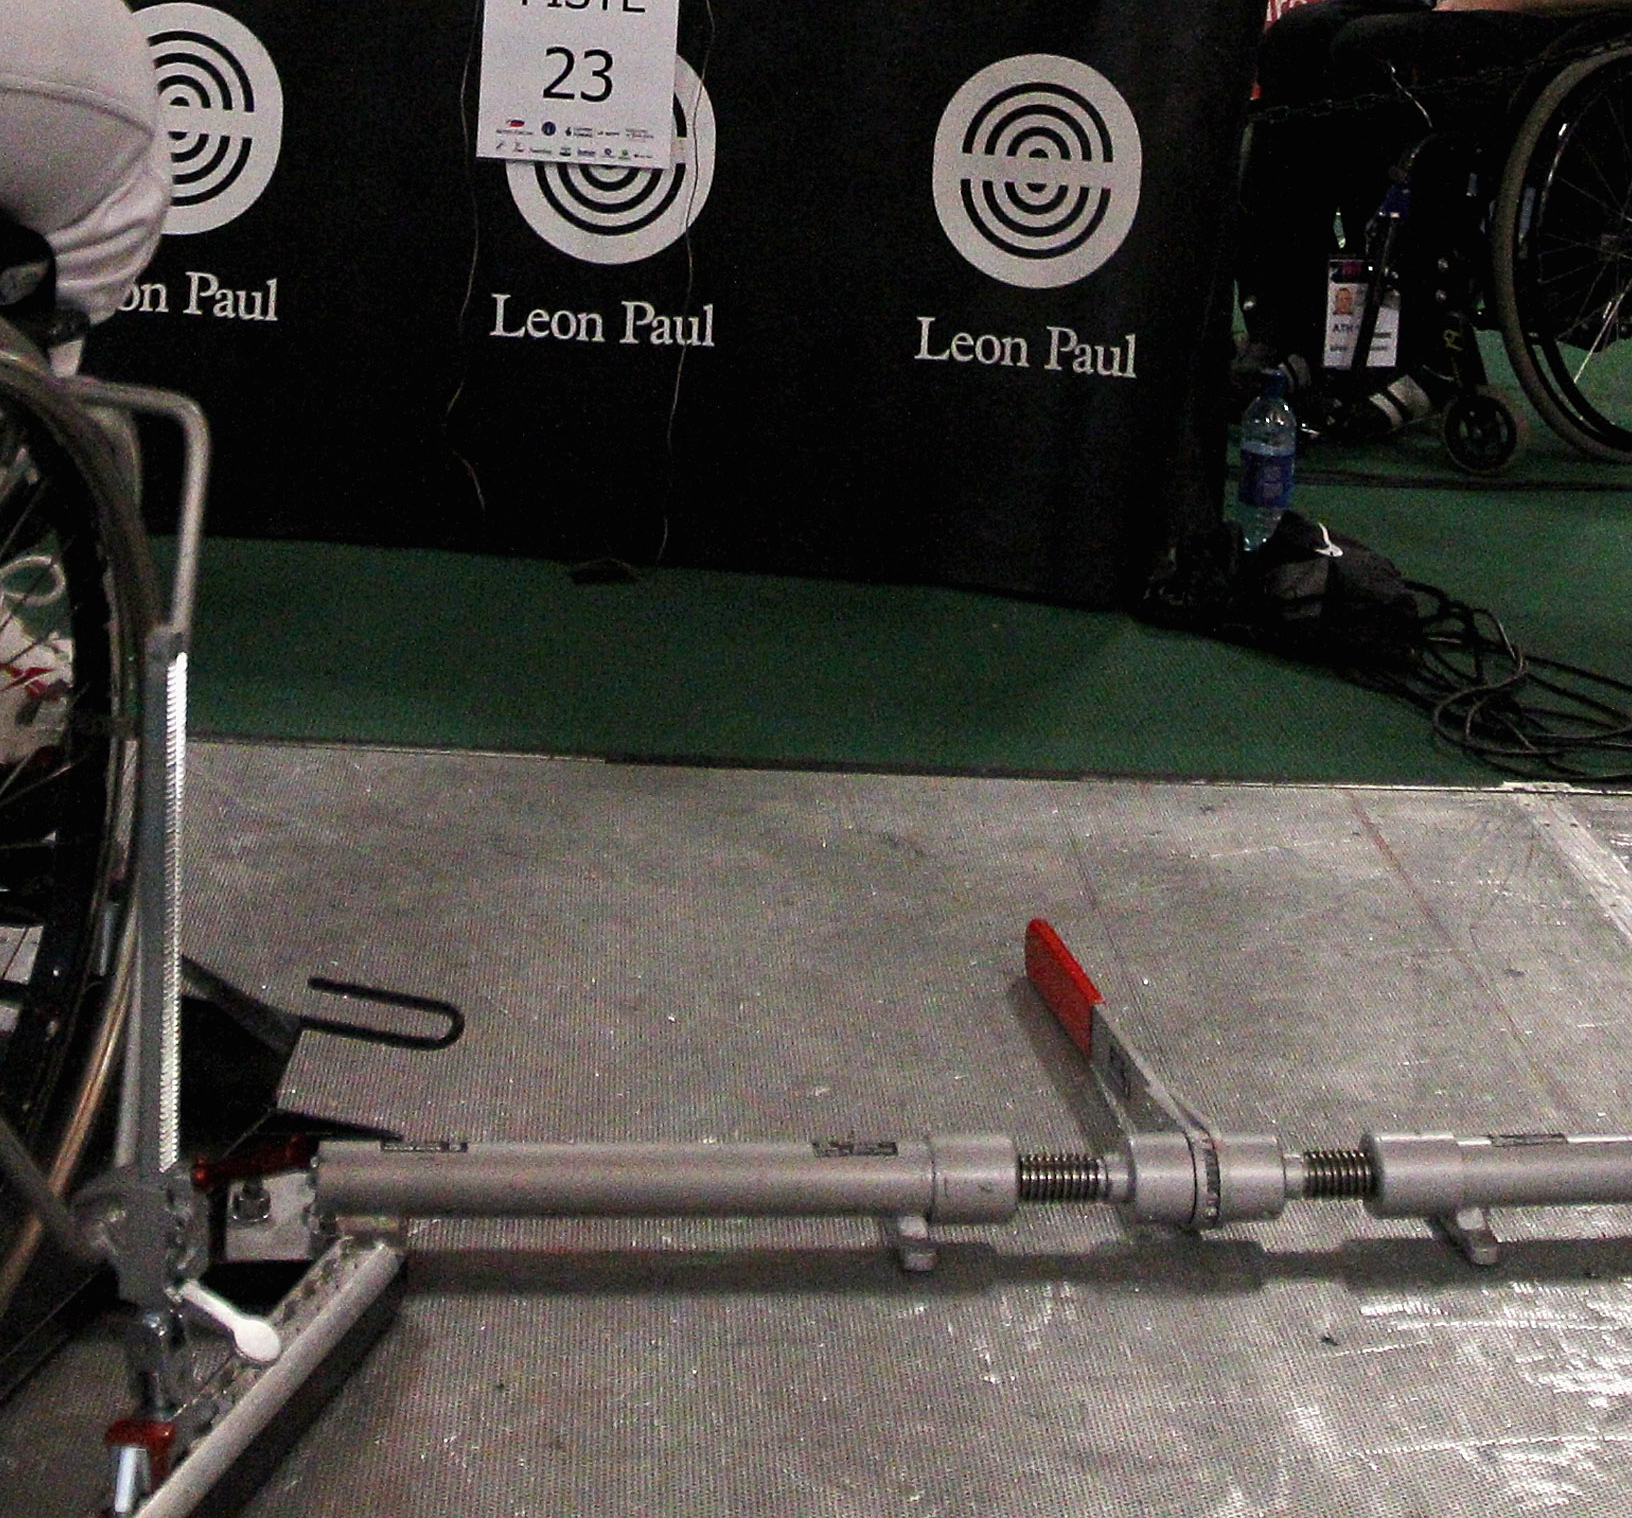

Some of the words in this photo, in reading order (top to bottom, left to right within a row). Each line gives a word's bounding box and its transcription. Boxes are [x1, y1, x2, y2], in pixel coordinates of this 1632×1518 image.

[542, 46, 614, 102] 23
[117, 281, 169, 314] on
[182, 271, 280, 321] Paul
[489, 293, 606, 343] Leon
[619, 300, 715, 347] Paul
[914, 316, 1030, 367] Leon
[1044, 325, 1138, 379] Paul
